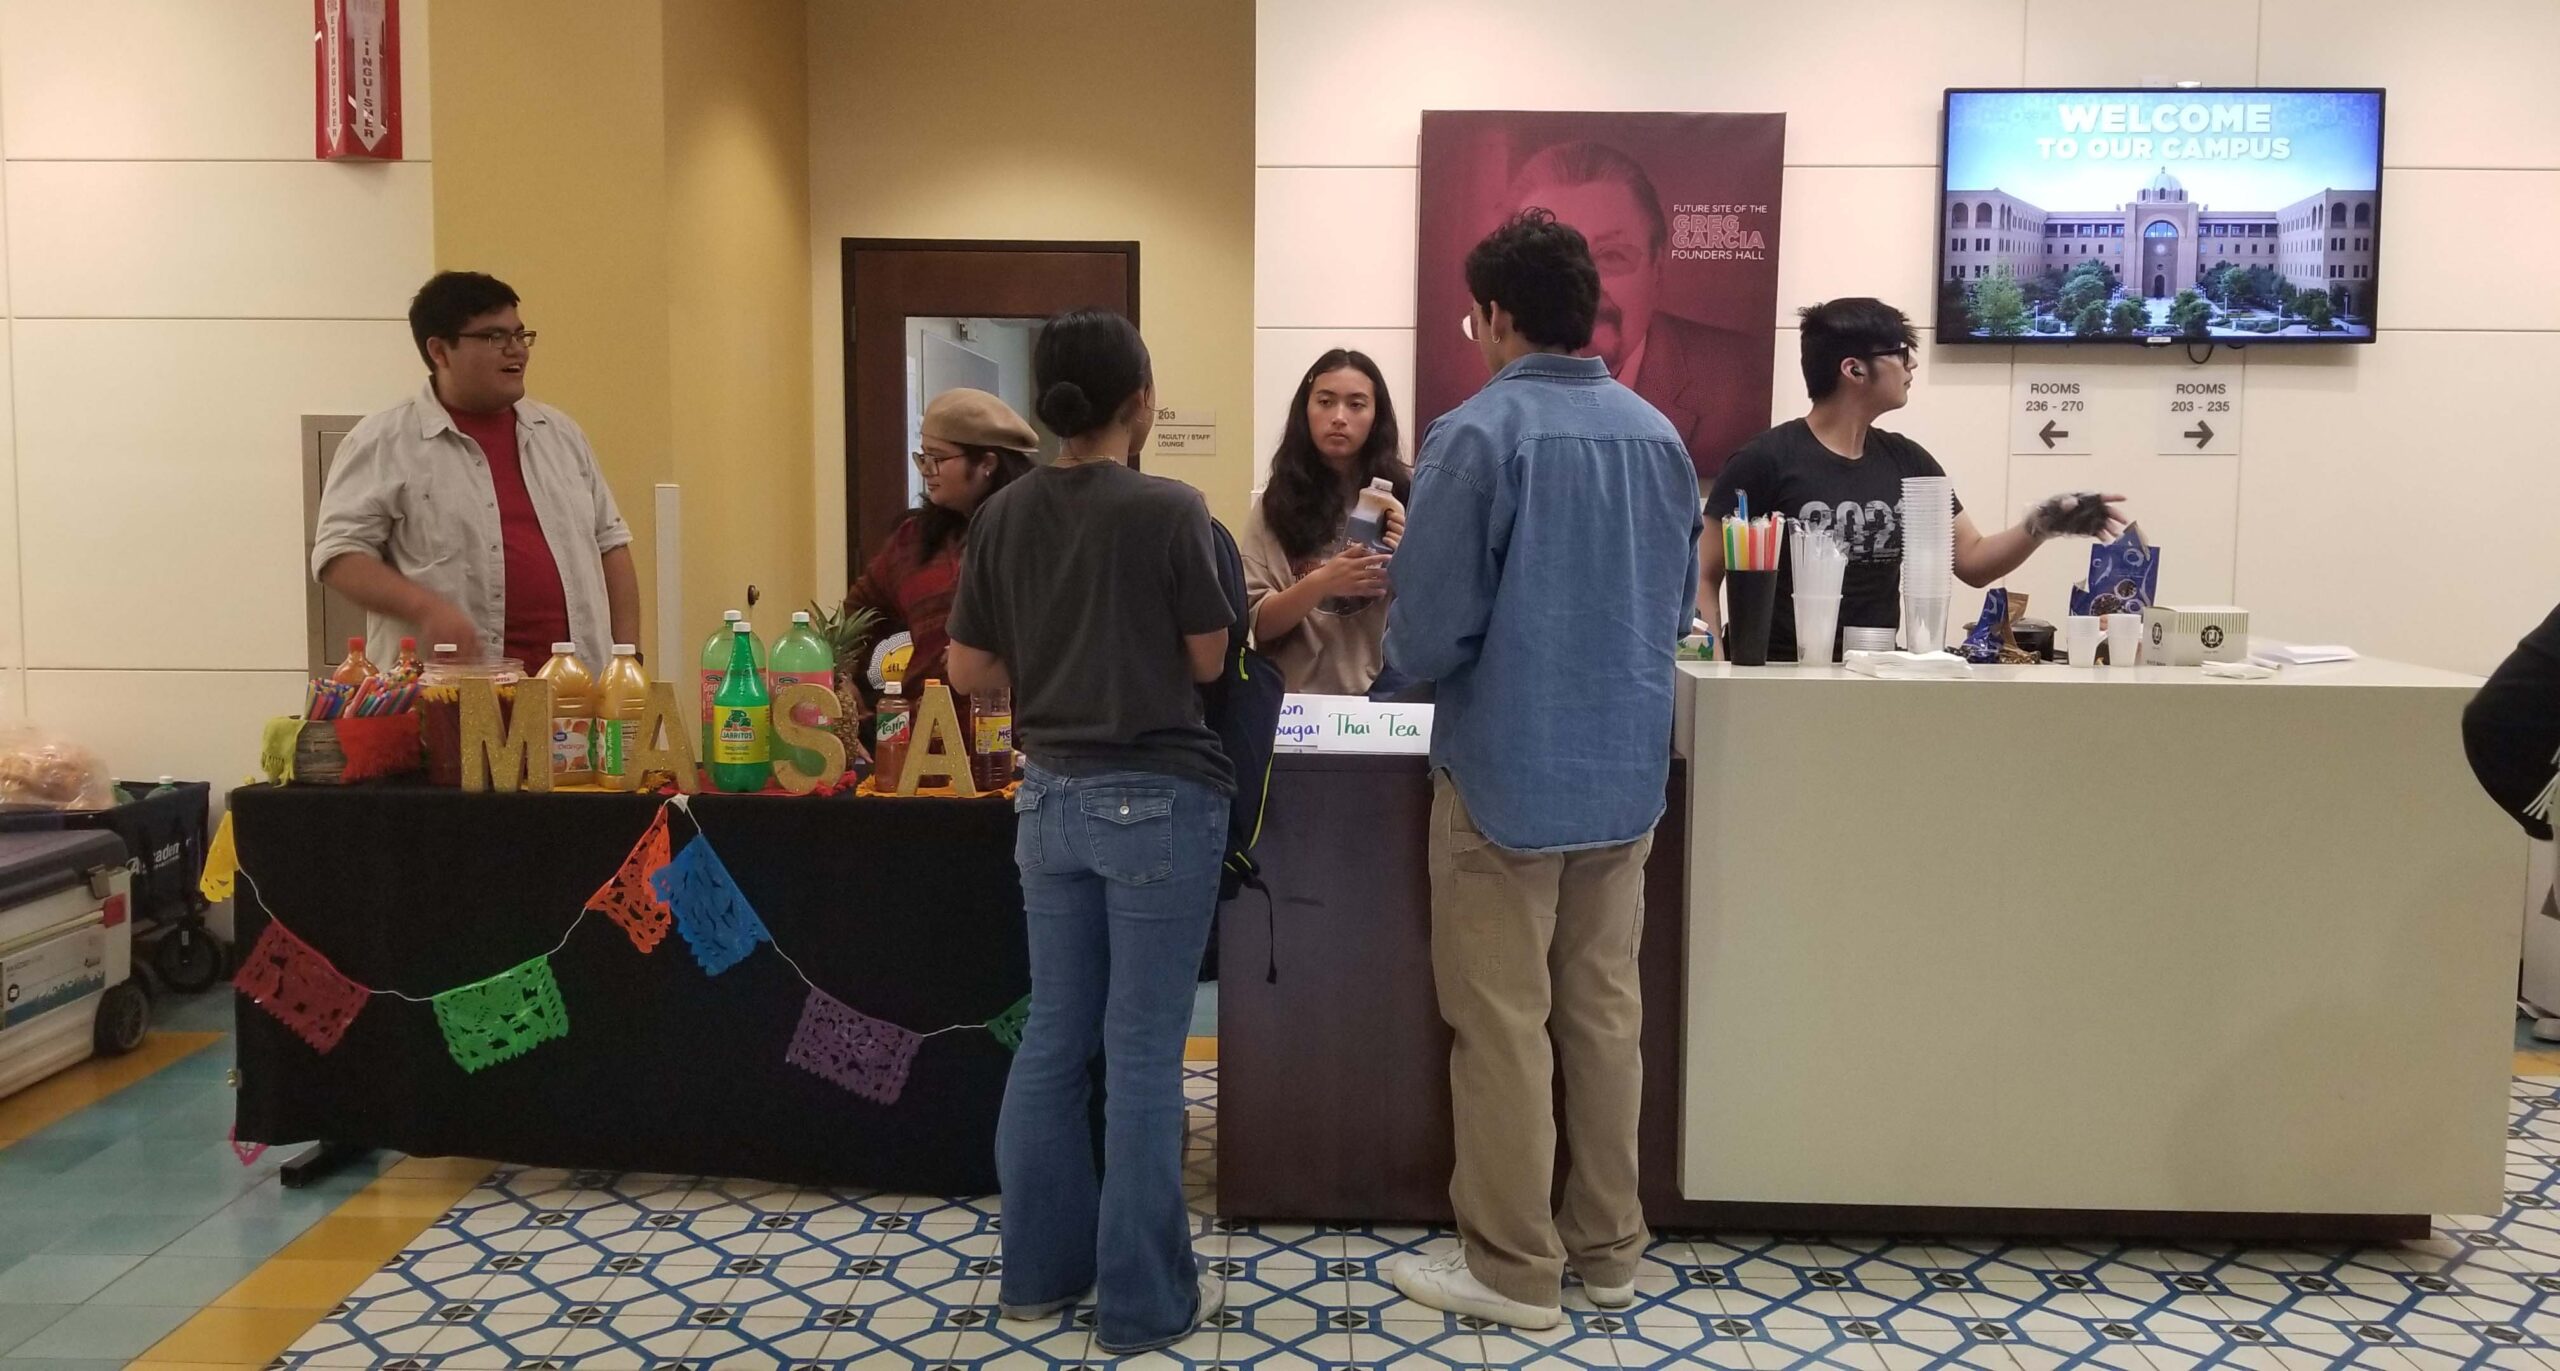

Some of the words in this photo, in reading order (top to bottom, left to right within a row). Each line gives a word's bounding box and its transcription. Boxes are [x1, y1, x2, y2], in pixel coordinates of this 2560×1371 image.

[2058, 103, 2273, 134] WELCOME
[2036, 137, 2079, 160] TO
[2087, 137, 2153, 160] OUR
[2161, 137, 2291, 160] CAMPUS
[1673, 204, 1710, 213] FUTURE
[1712, 204, 1731, 213] SITE
[1734, 204, 1747, 213] OF
[1749, 205, 1768, 214] THE
[1672, 214, 1740, 233] GREG
[1672, 230, 1765, 249] GARCIA
[1671, 249, 1733, 260] FOUNDERS
[1735, 250, 1765, 260] HALL
[2030, 383, 2080, 395] ROOMS
[2176, 383, 2226, 395] ROOMS
[2025, 401, 2048, 412] 236
[2061, 401, 2084, 412] 270
[2171, 401, 2194, 412] 203
[2207, 401, 2230, 412] 235
[1158, 411, 1176, 420] 203
[1328, 712, 1370, 737] Thai
[1379, 712, 1421, 737] Tea
[721, 731, 753, 740] JARRITOS
